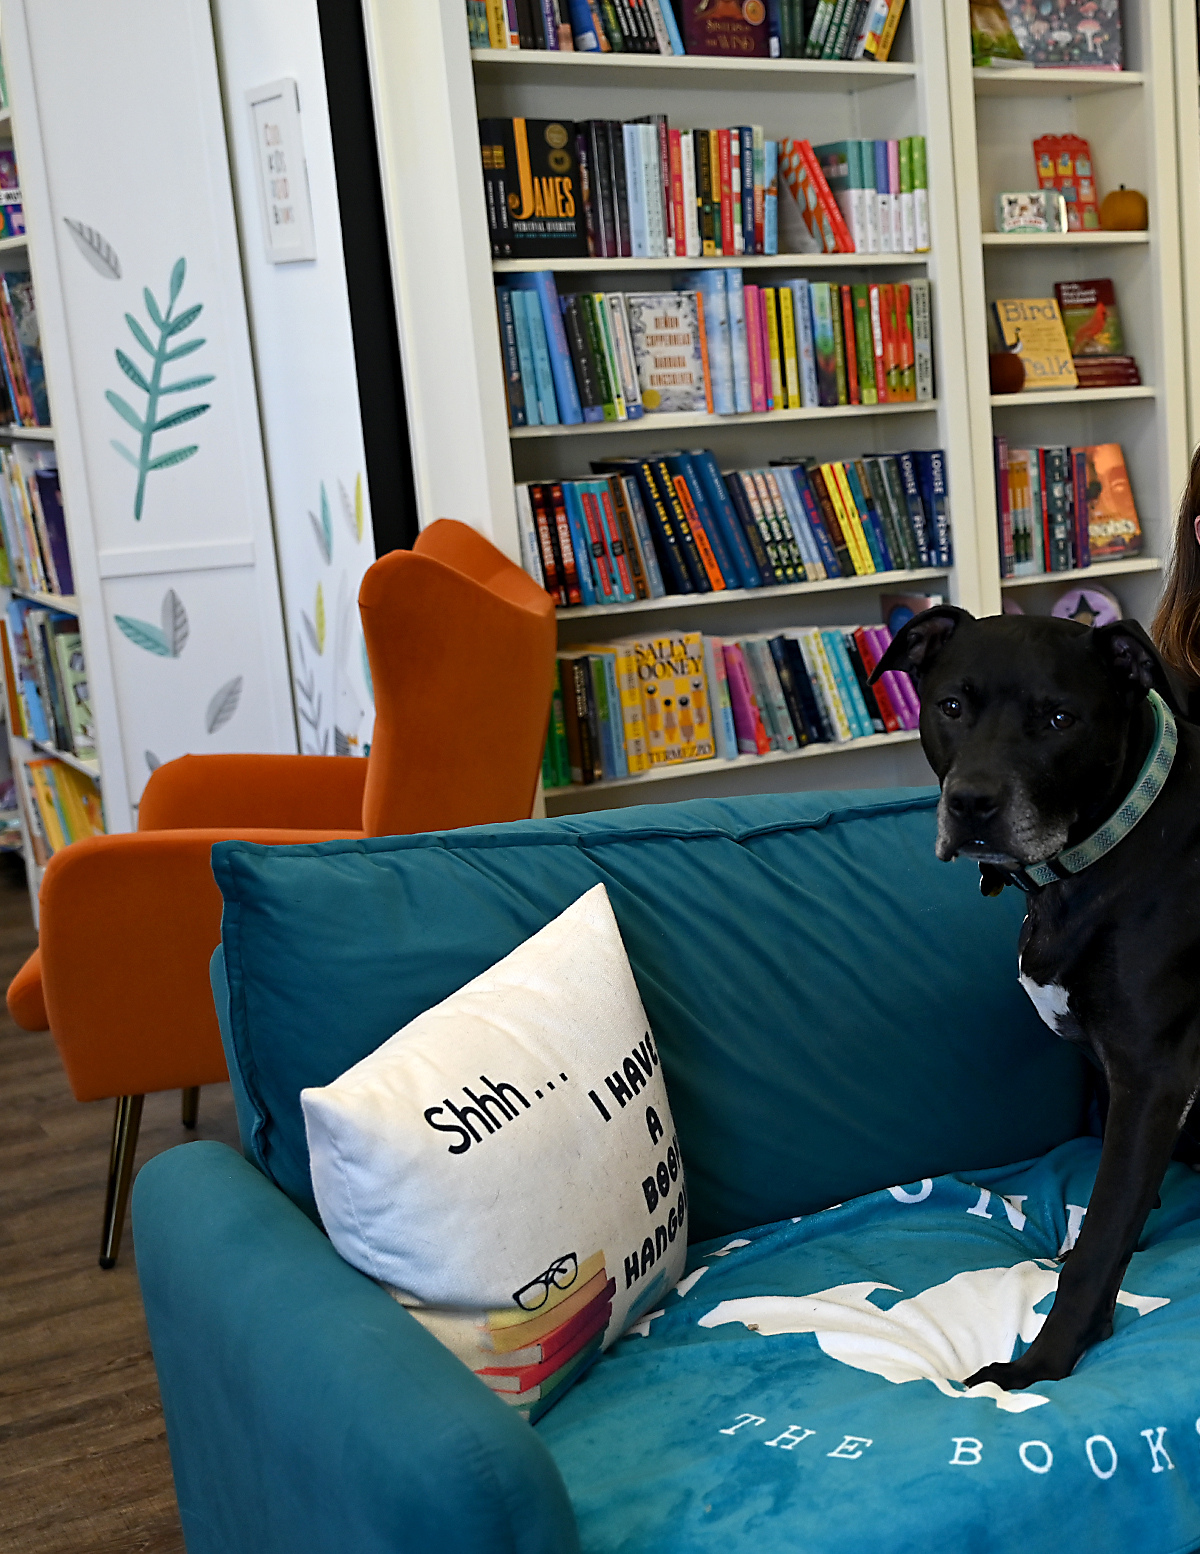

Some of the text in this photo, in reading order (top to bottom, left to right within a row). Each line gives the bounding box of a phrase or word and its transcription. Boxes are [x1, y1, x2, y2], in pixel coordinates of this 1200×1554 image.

[508, 117, 575, 219] JAMES
[1002, 301, 1058, 322] Bird
[642, 463, 660, 499] PEOPLE
[659, 462, 677, 498] PEOPLE
[901, 452, 929, 556] LOUISE PENNY
[931, 453, 949, 557] LOUISE PENNY
[634, 637, 692, 662] SALLY
[588, 1031, 659, 1122] I HAVE
[645, 1106, 664, 1145] A
[719, 1412, 873, 1460] THE
